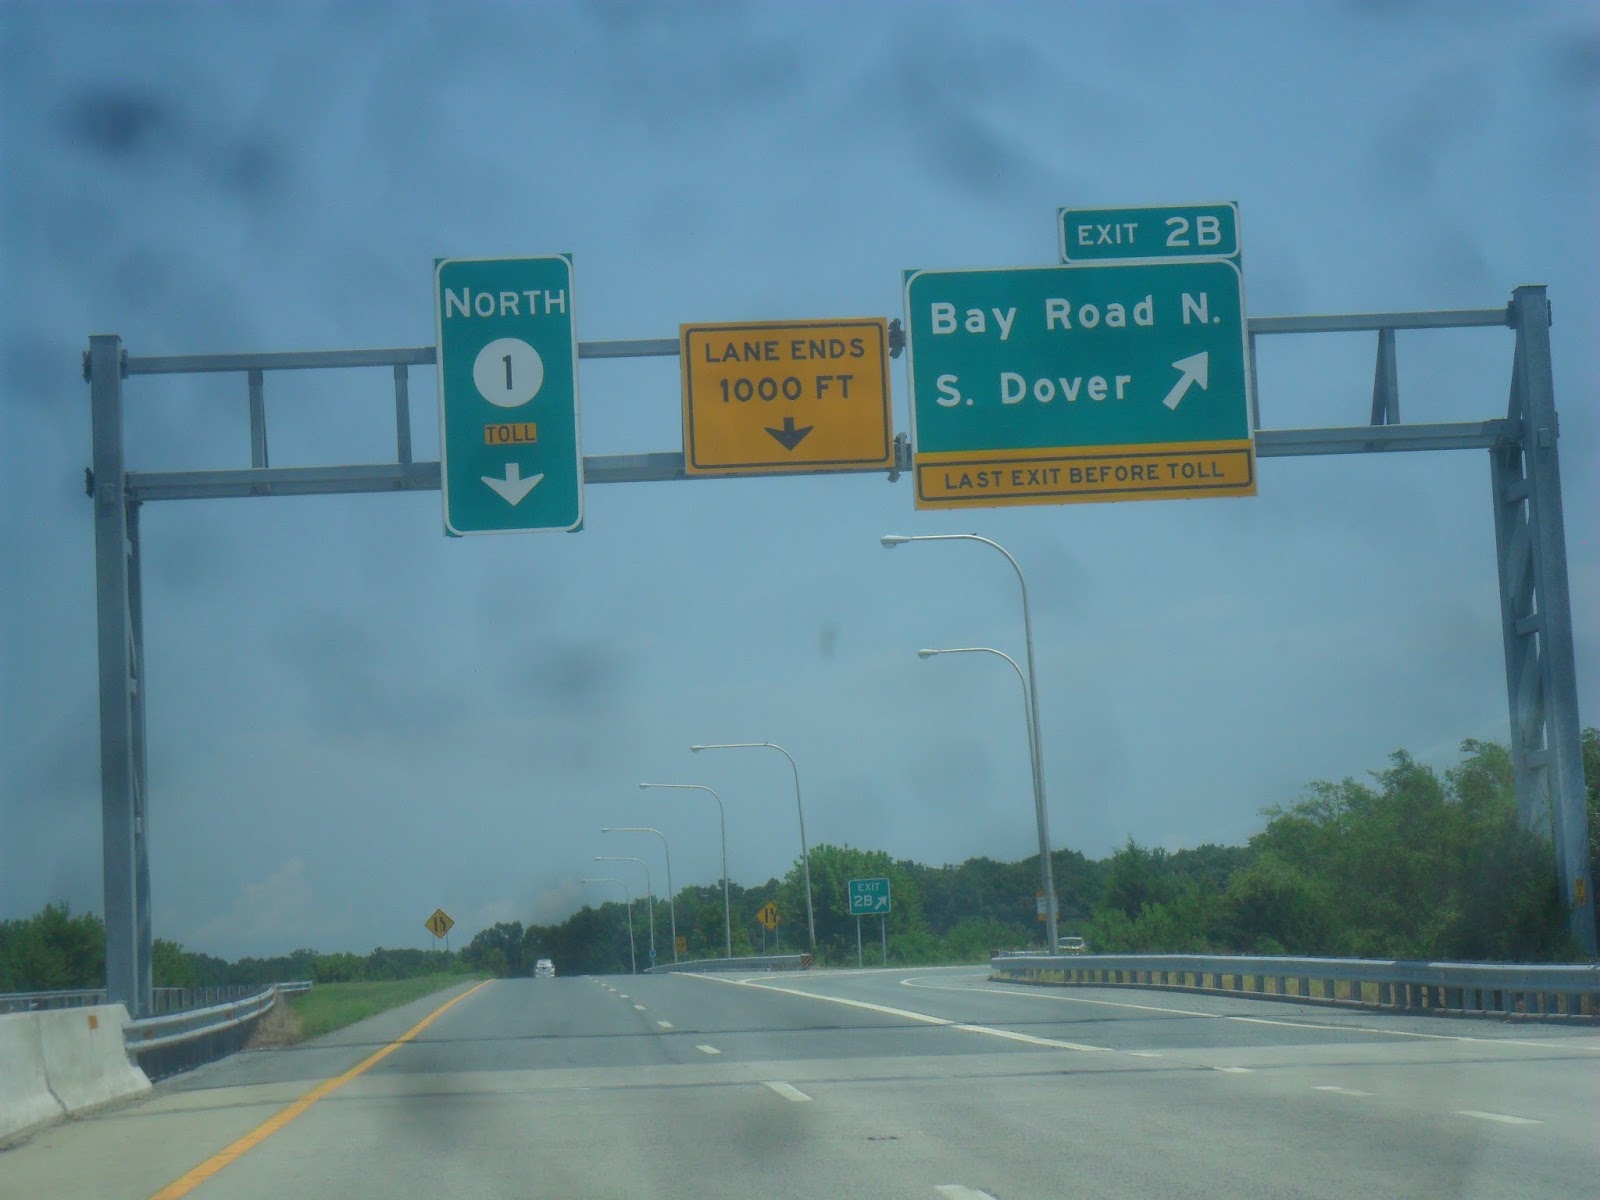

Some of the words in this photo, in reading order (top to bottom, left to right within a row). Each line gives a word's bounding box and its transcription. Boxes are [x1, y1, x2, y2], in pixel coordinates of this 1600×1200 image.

[1077, 223, 1138, 246] EXIT
[1164, 215, 1222, 247] 2B
[444, 287, 566, 318] NORTH
[930, 302, 1017, 341] Bay
[1045, 294, 1154, 330] Road
[1181, 292, 1221, 325] N.
[705, 340, 780, 364] LANE
[790, 337, 866, 361] ENDS
[502, 354, 514, 391] 1
[720, 376, 802, 403] 1000
[816, 374, 854, 400] FT
[935, 374, 974, 408] S.
[1000, 371, 1132, 405] Dover
[485, 425, 536, 444] TOLL
[944, 470, 1004, 491] LAST
[1011, 467, 1061, 487] EXIT
[1069, 463, 1160, 483] BEFORE
[1166, 461, 1225, 480] TOLL
[853, 894, 873, 907] 2B
[857, 882, 880, 892] EXIT
